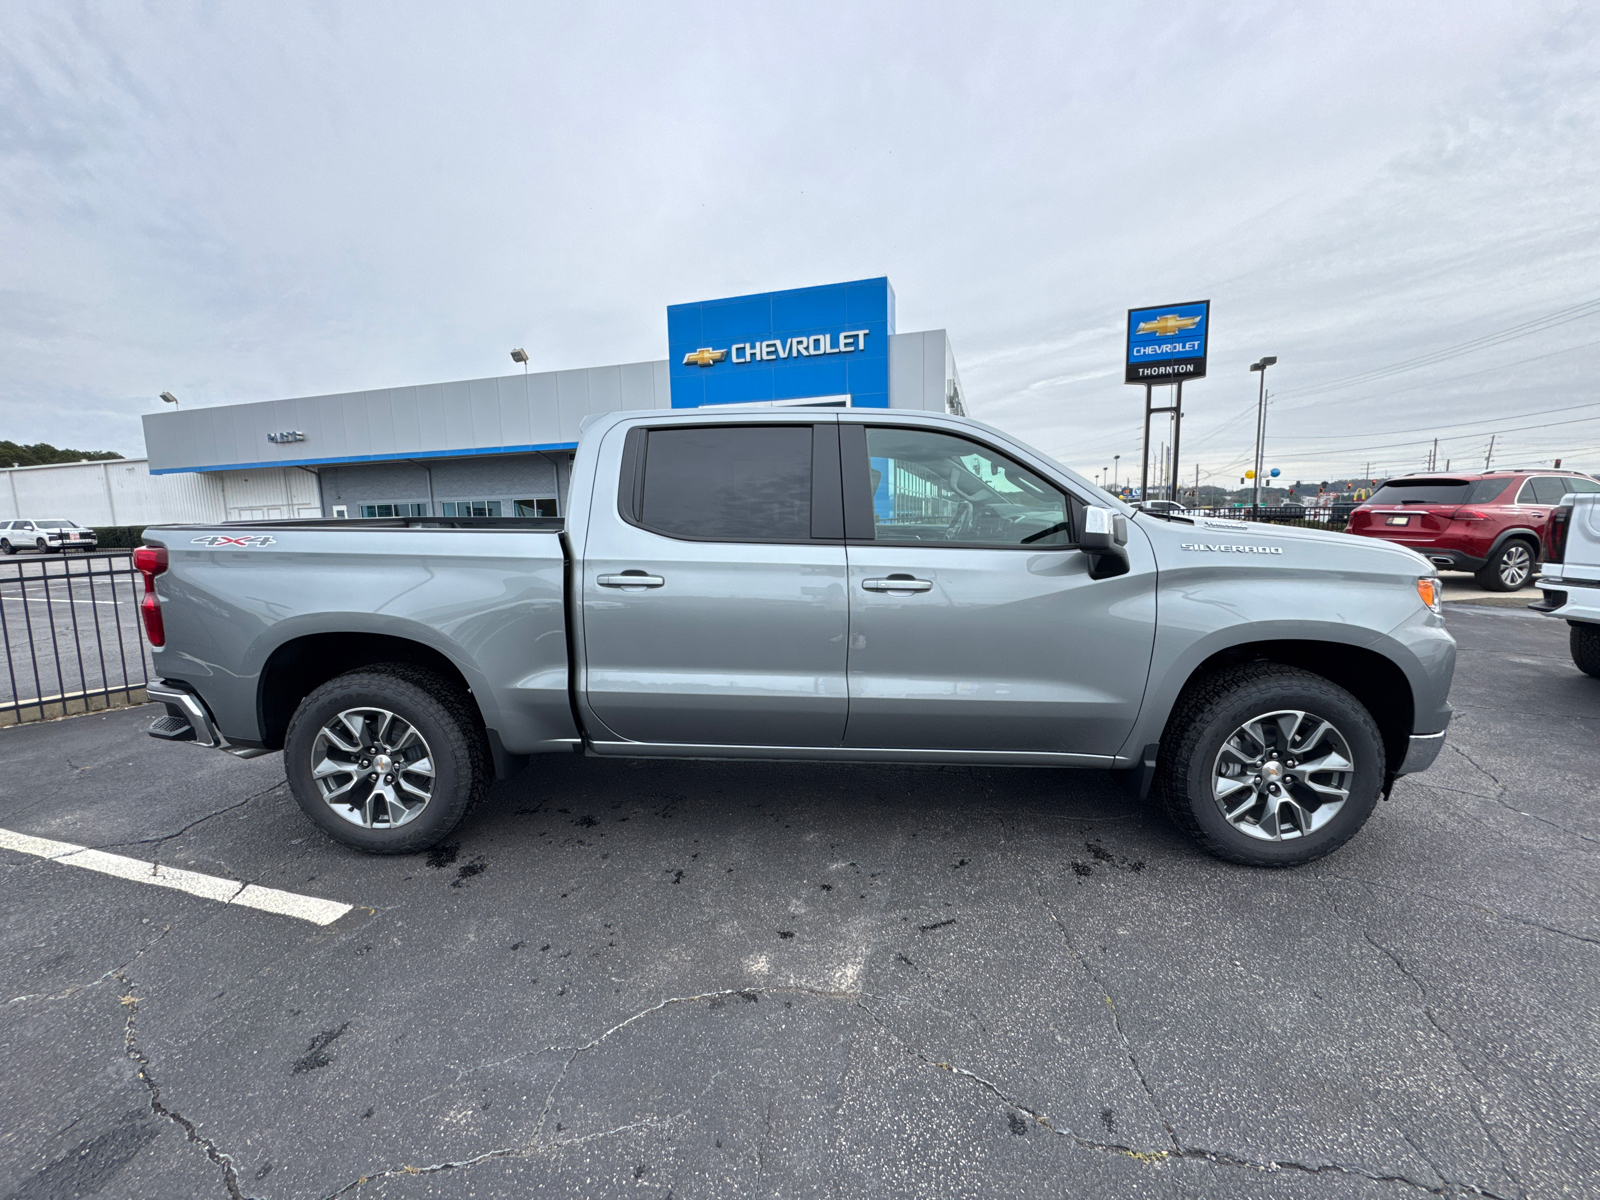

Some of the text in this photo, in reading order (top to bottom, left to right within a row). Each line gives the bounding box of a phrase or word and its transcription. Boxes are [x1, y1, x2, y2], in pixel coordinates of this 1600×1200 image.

[731, 329, 869, 364] CHEVROLET
[1133, 341, 1200, 356] CHEVROLET
[1138, 364, 1194, 376] THORNTON
[1181, 543, 1283, 554] SILVERADO
